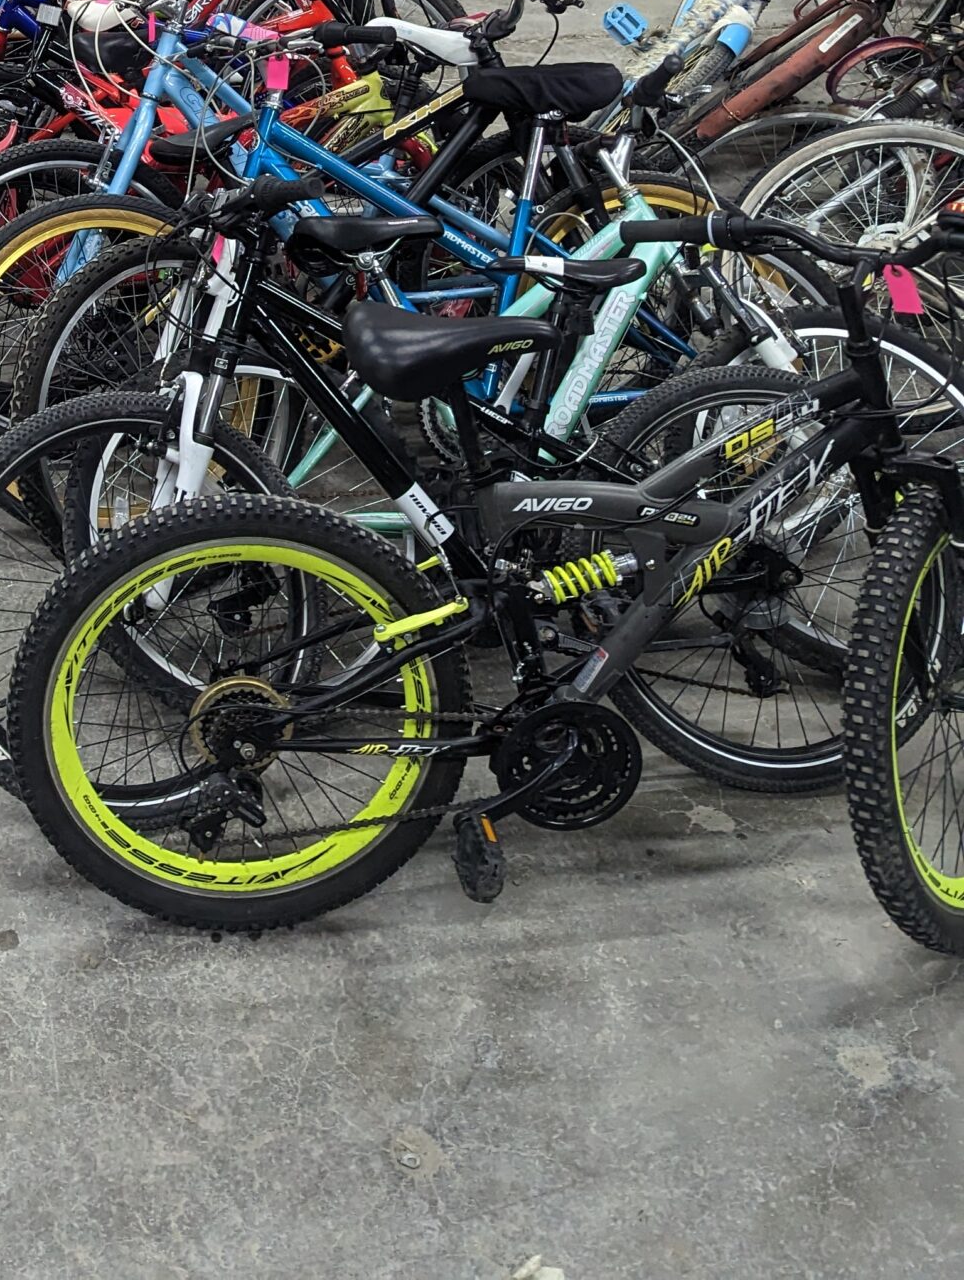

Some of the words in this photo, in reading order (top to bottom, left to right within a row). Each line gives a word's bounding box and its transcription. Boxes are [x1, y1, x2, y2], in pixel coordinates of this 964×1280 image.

[383, 83, 464, 140] KHS
[488, 339, 534, 355] AVIGO
[545, 289, 636, 438] ROADMASTER
[512, 497, 594, 512] AVIGO
